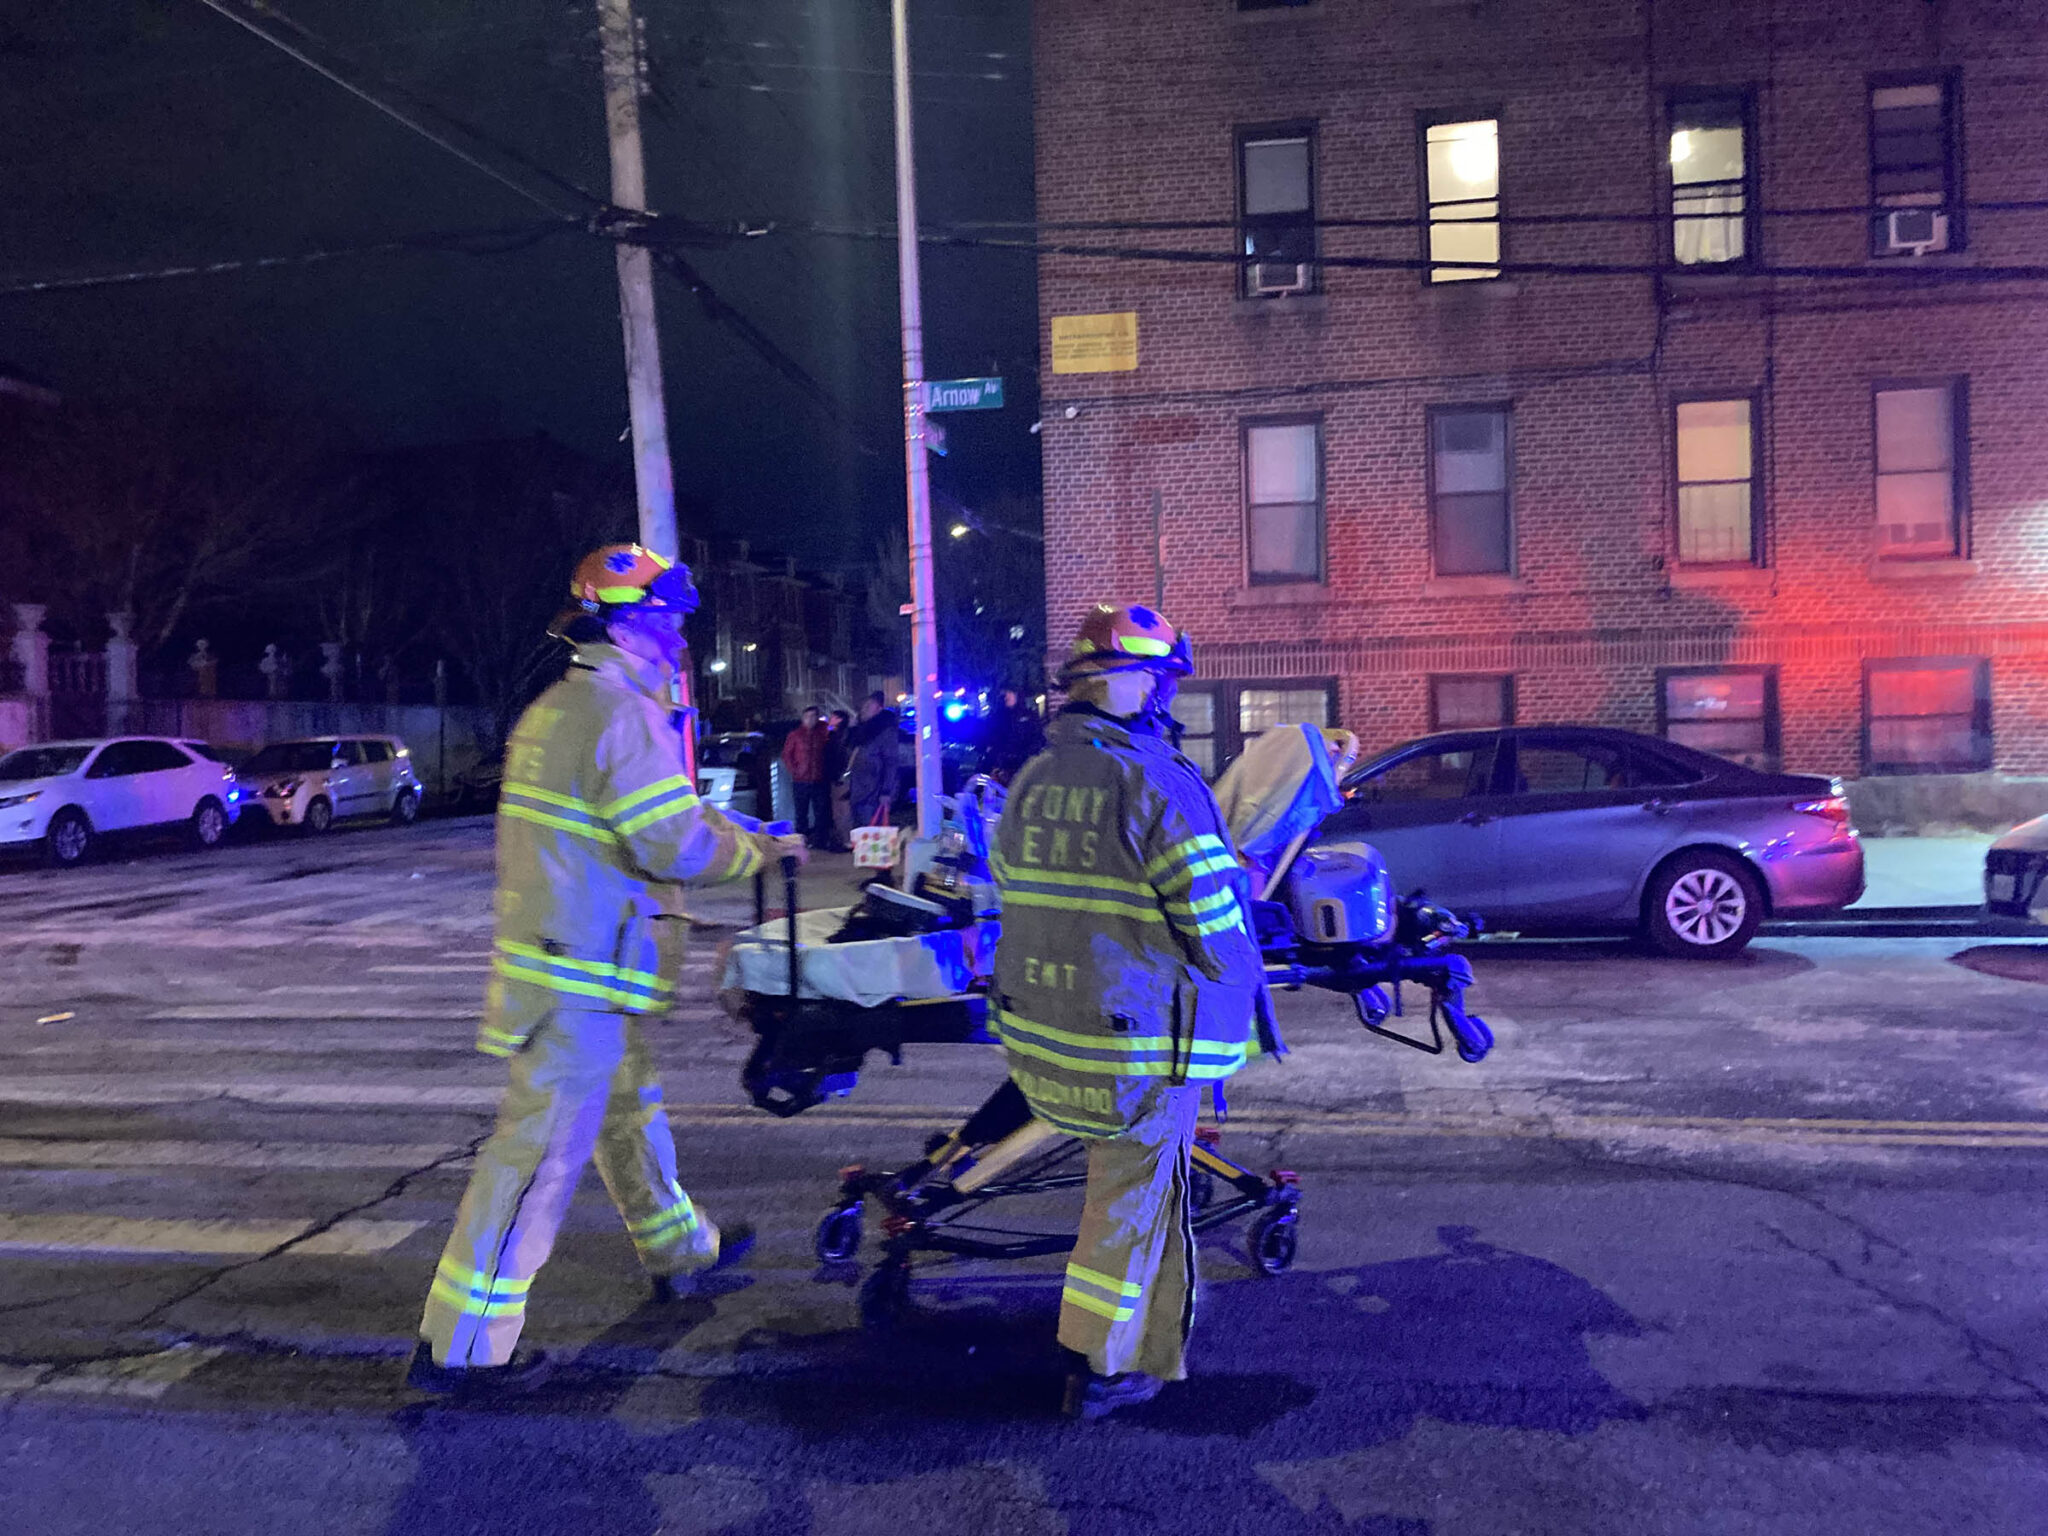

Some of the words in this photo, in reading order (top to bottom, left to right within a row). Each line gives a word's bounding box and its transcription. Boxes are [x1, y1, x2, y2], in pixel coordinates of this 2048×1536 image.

[932, 385, 980, 407] Arnow
[985, 382, 998, 394] Av
[1021, 784, 1109, 826] FDNY
[1022, 826, 1099, 870] EMS
[1025, 957, 1077, 990] EMT
